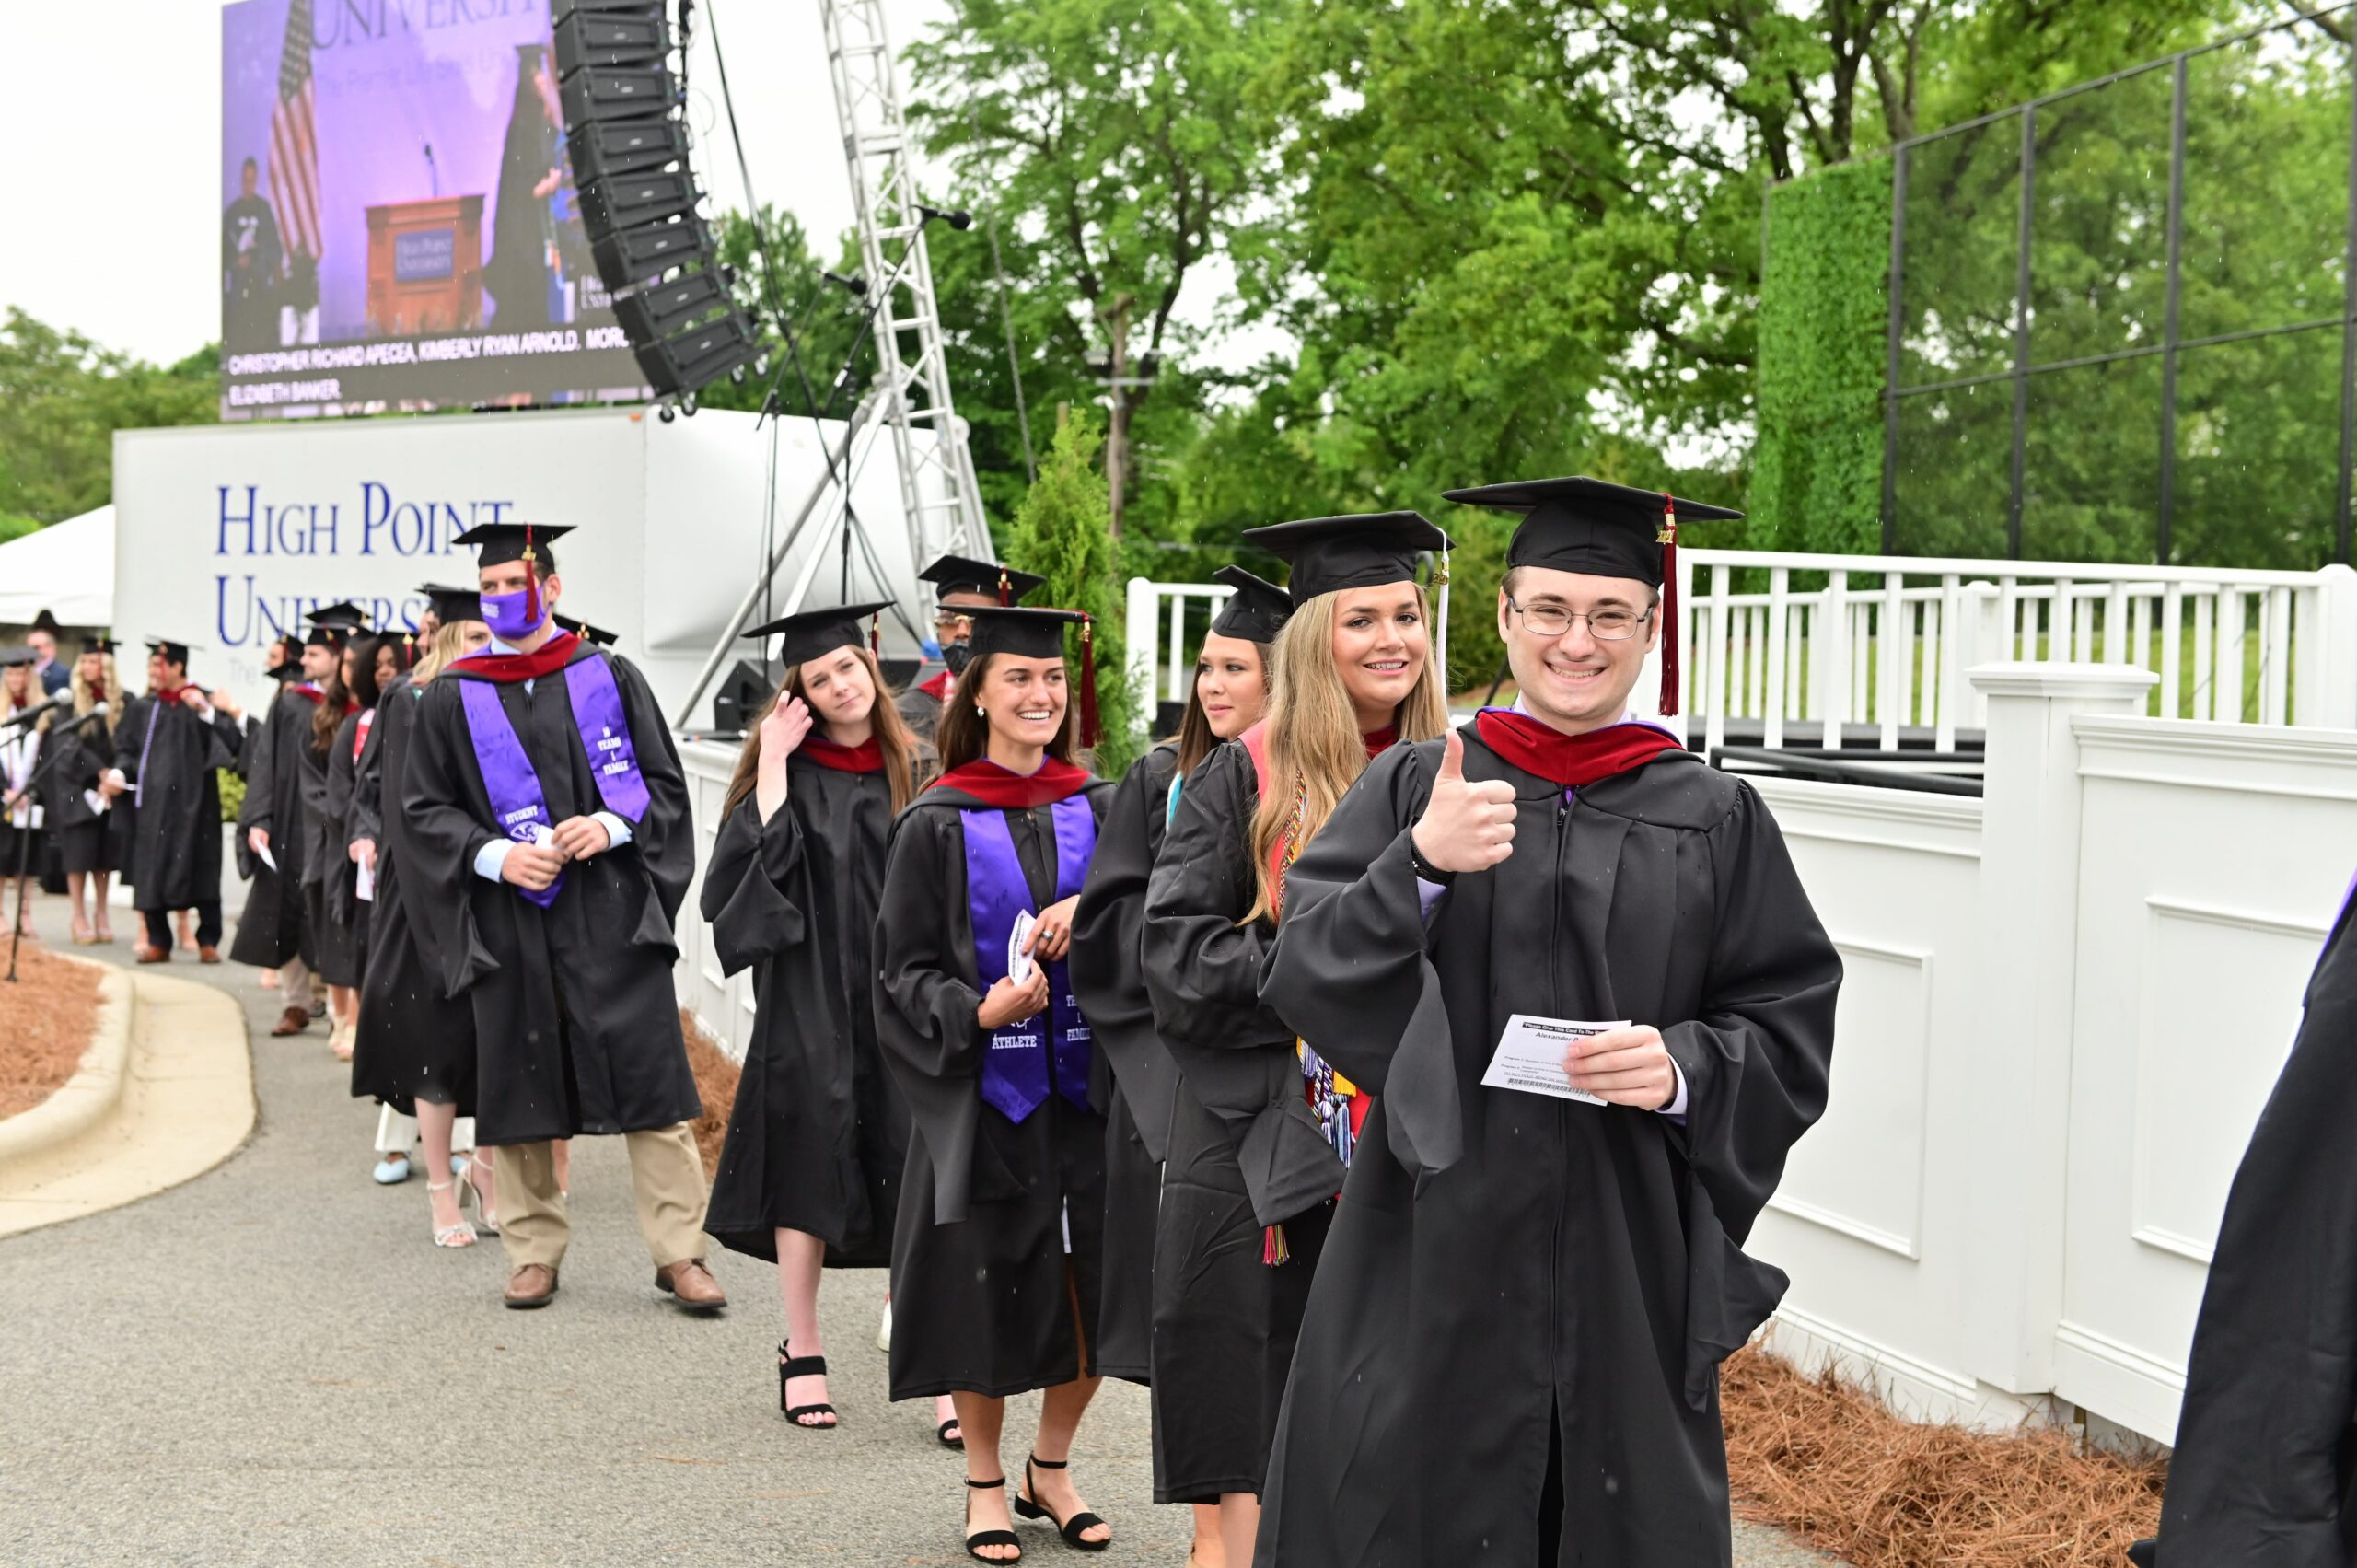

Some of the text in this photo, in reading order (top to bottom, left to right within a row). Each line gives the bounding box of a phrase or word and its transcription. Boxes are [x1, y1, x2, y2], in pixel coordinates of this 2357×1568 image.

[308, 0, 539, 50] UNIVERS
[215, 485, 340, 556] HIGH
[505, 804, 538, 825] STUDENT
[991, 1035, 1037, 1050] ATHLETE
[1535, 1031, 1573, 1042] Alexander
